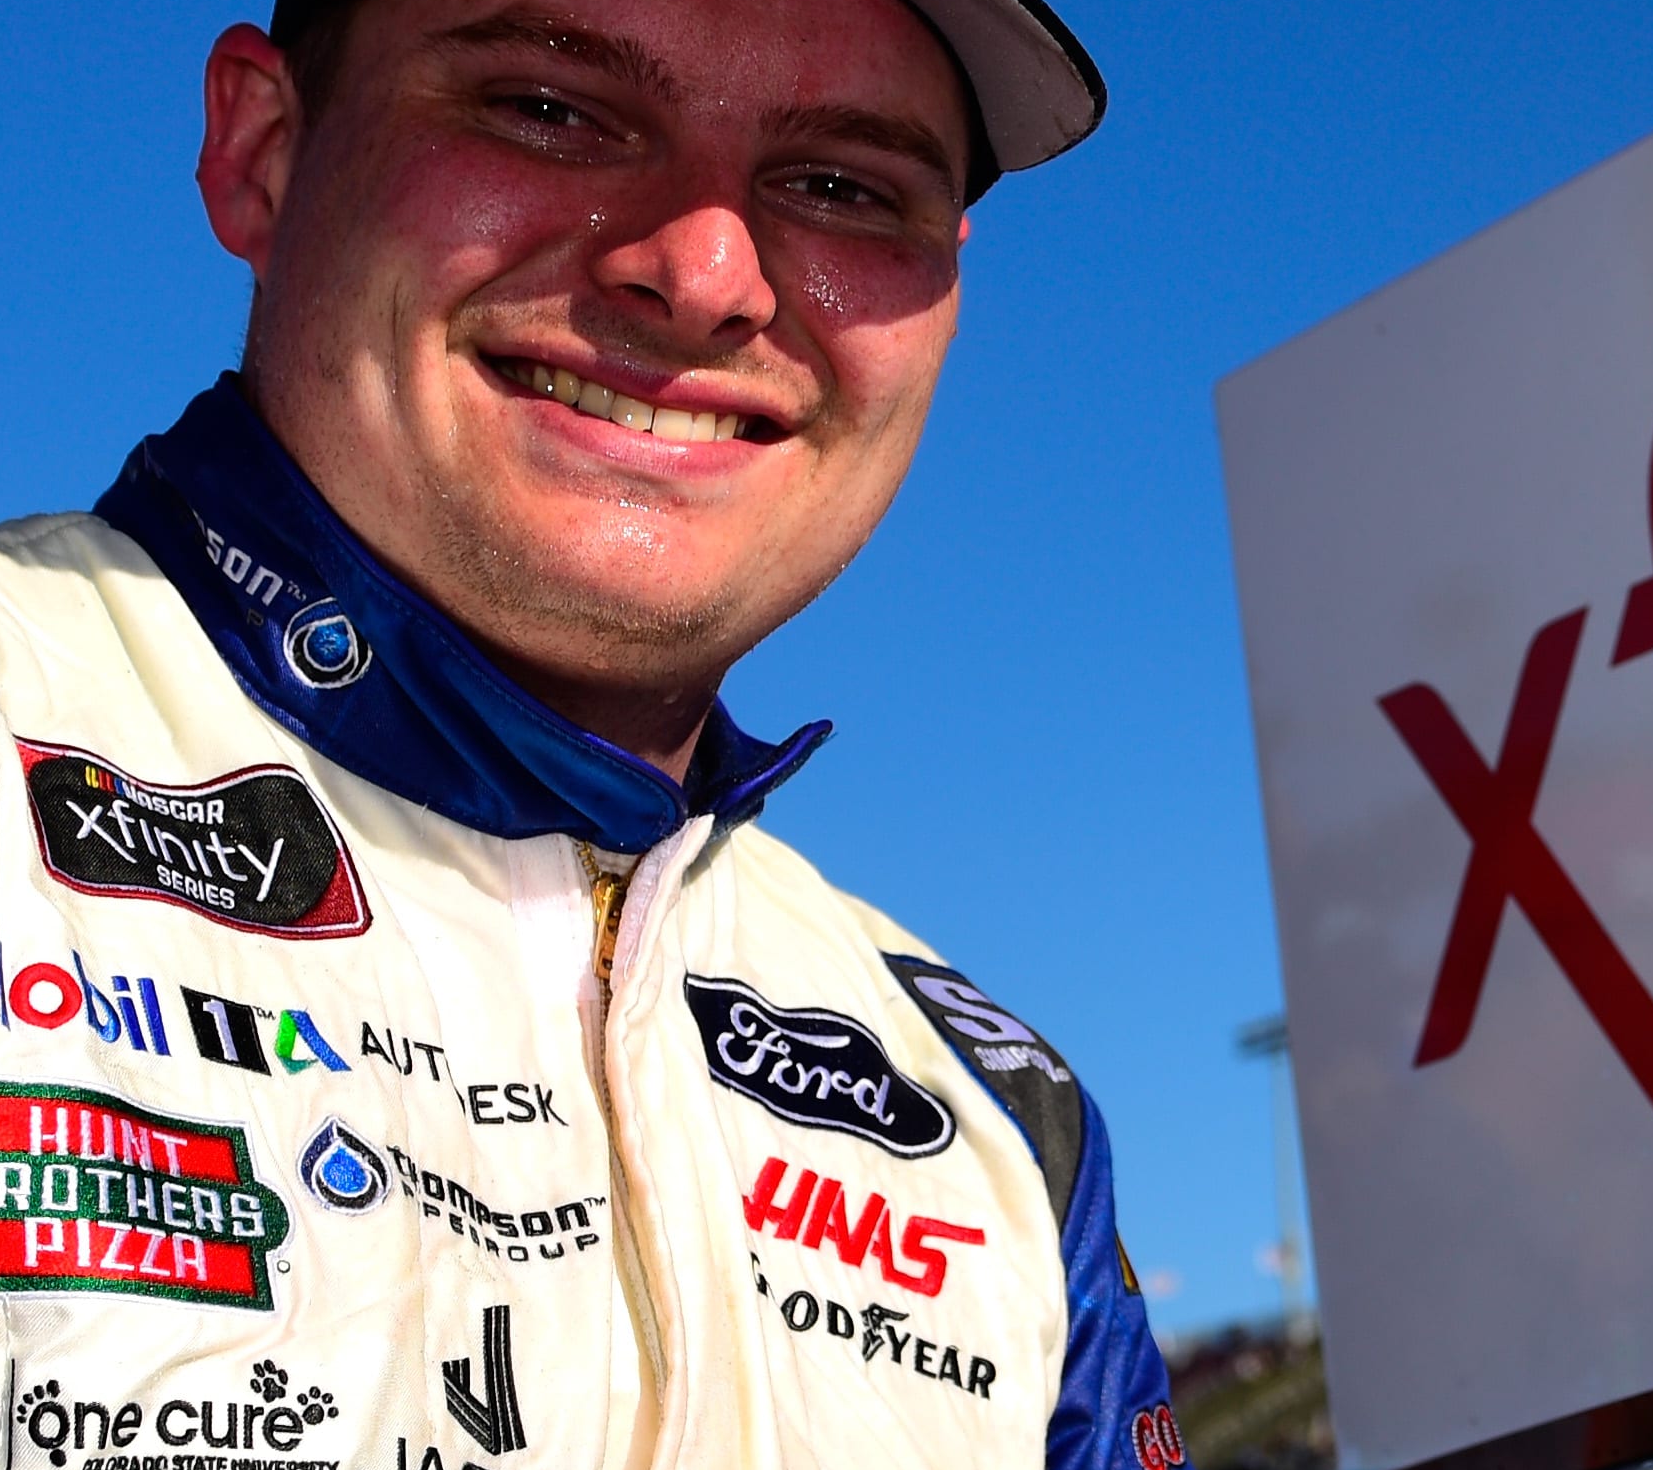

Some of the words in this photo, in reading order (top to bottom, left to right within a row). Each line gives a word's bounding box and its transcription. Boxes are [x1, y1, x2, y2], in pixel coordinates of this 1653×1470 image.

[120, 782, 225, 825] NASCAR
[66, 798, 285, 903] xfinity
[156, 864, 236, 911] SERIES
[360, 1020, 570, 1128] AUTESK
[715, 1001, 896, 1128] Ford
[28, 1104, 189, 1178] HUNT
[23, 1220, 209, 1284] PIZZA
[742, 1156, 987, 1298] HAAS
[750, 1250, 997, 1401] GODYEAR
[155, 1399, 304, 1452] cure
